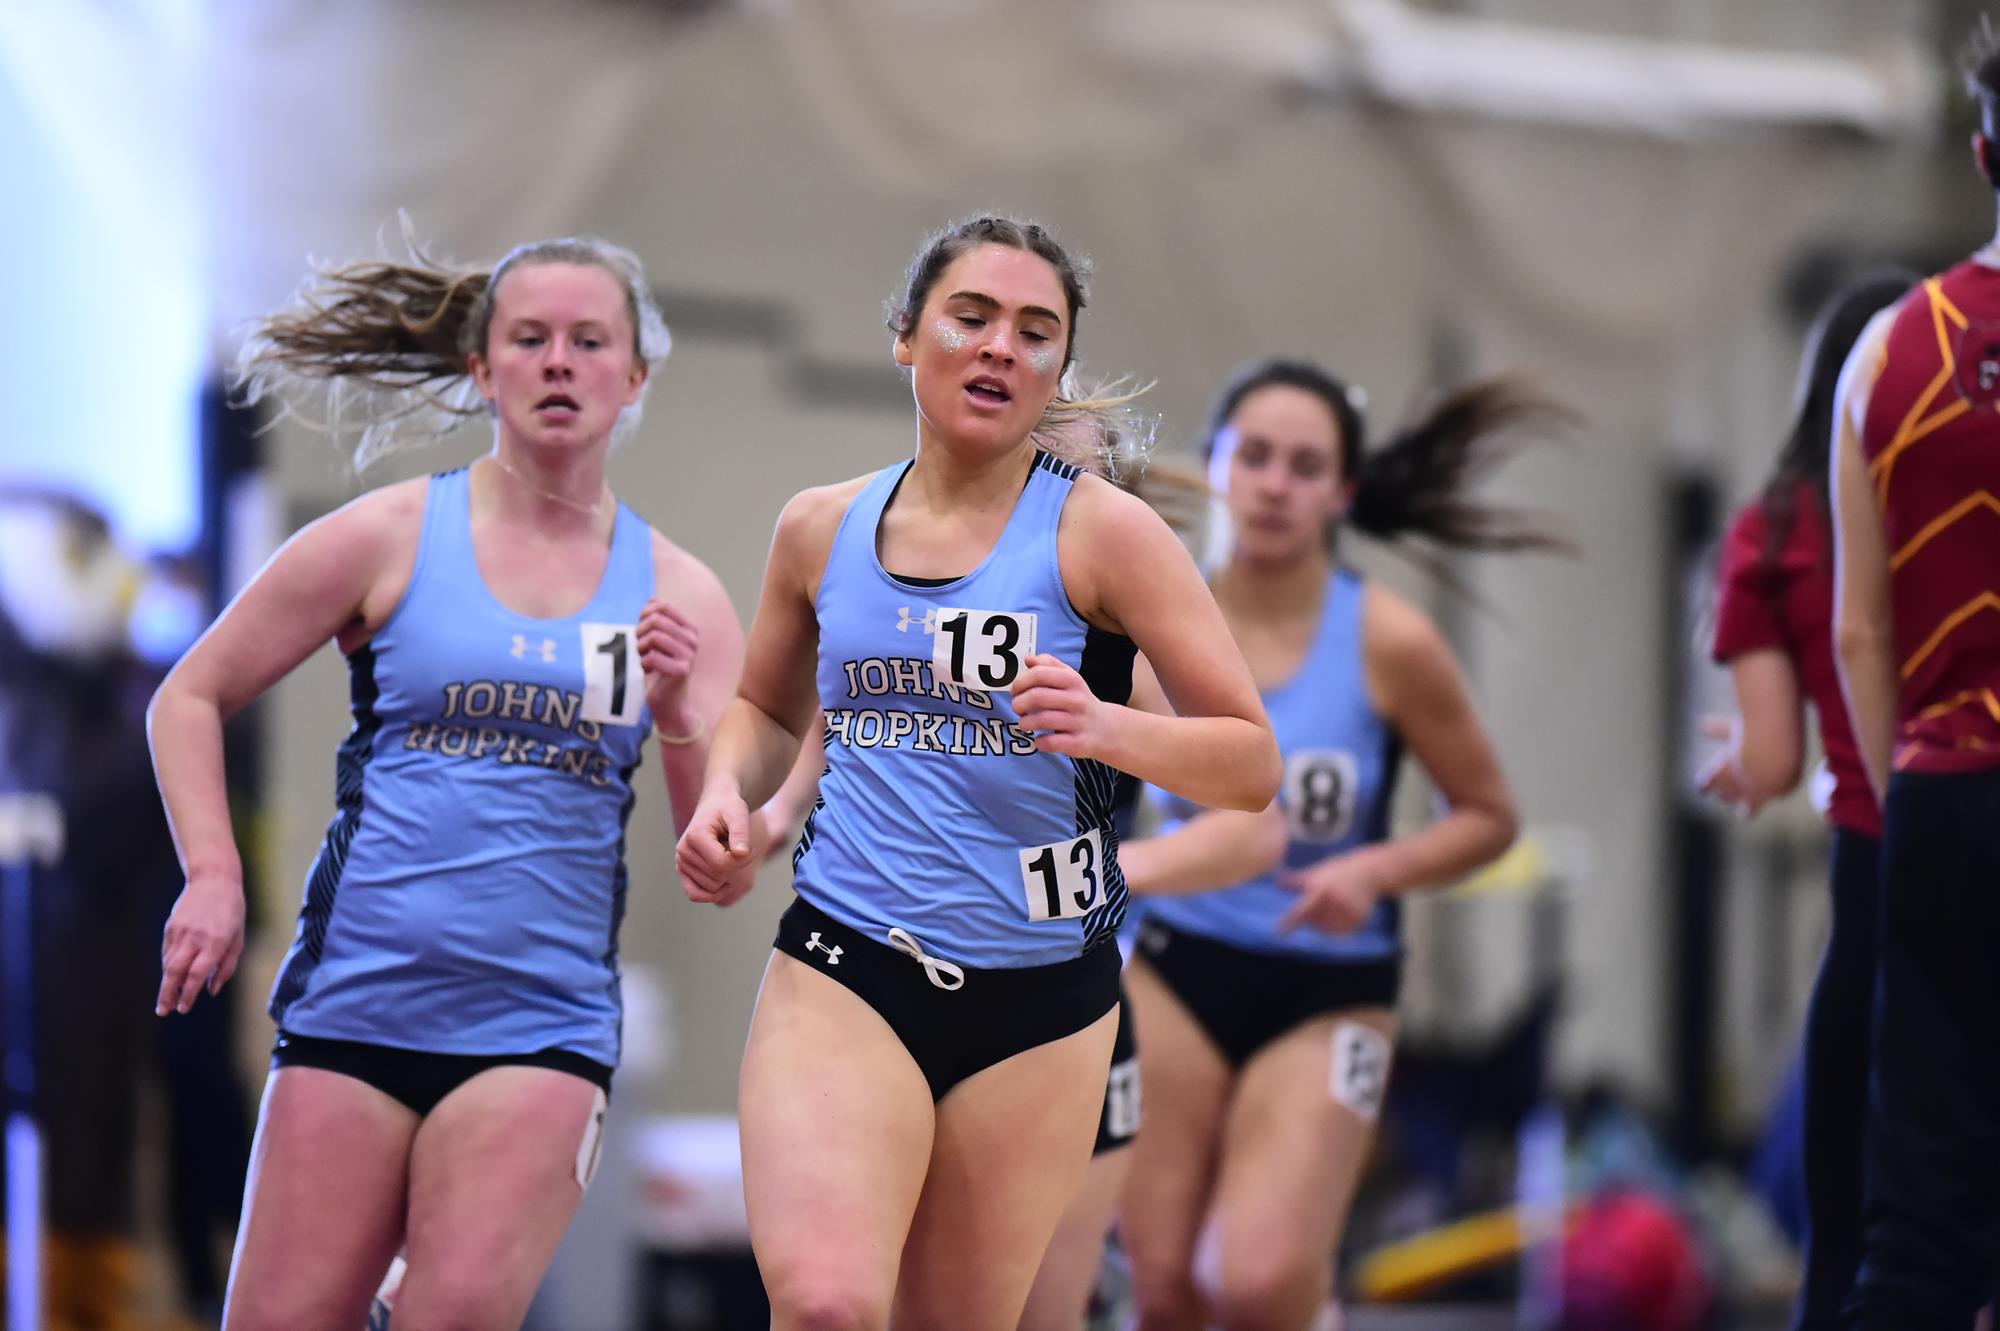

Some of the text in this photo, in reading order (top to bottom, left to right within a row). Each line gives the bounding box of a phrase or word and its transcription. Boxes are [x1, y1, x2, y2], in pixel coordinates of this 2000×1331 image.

[597, 632, 628, 717] 1
[941, 611, 1020, 689] 13
[403, 721, 616, 787] HOPKINS
[823, 708, 1038, 757] HOPKINS
[1301, 760, 1342, 834] 8
[1028, 838, 1097, 917] 13
